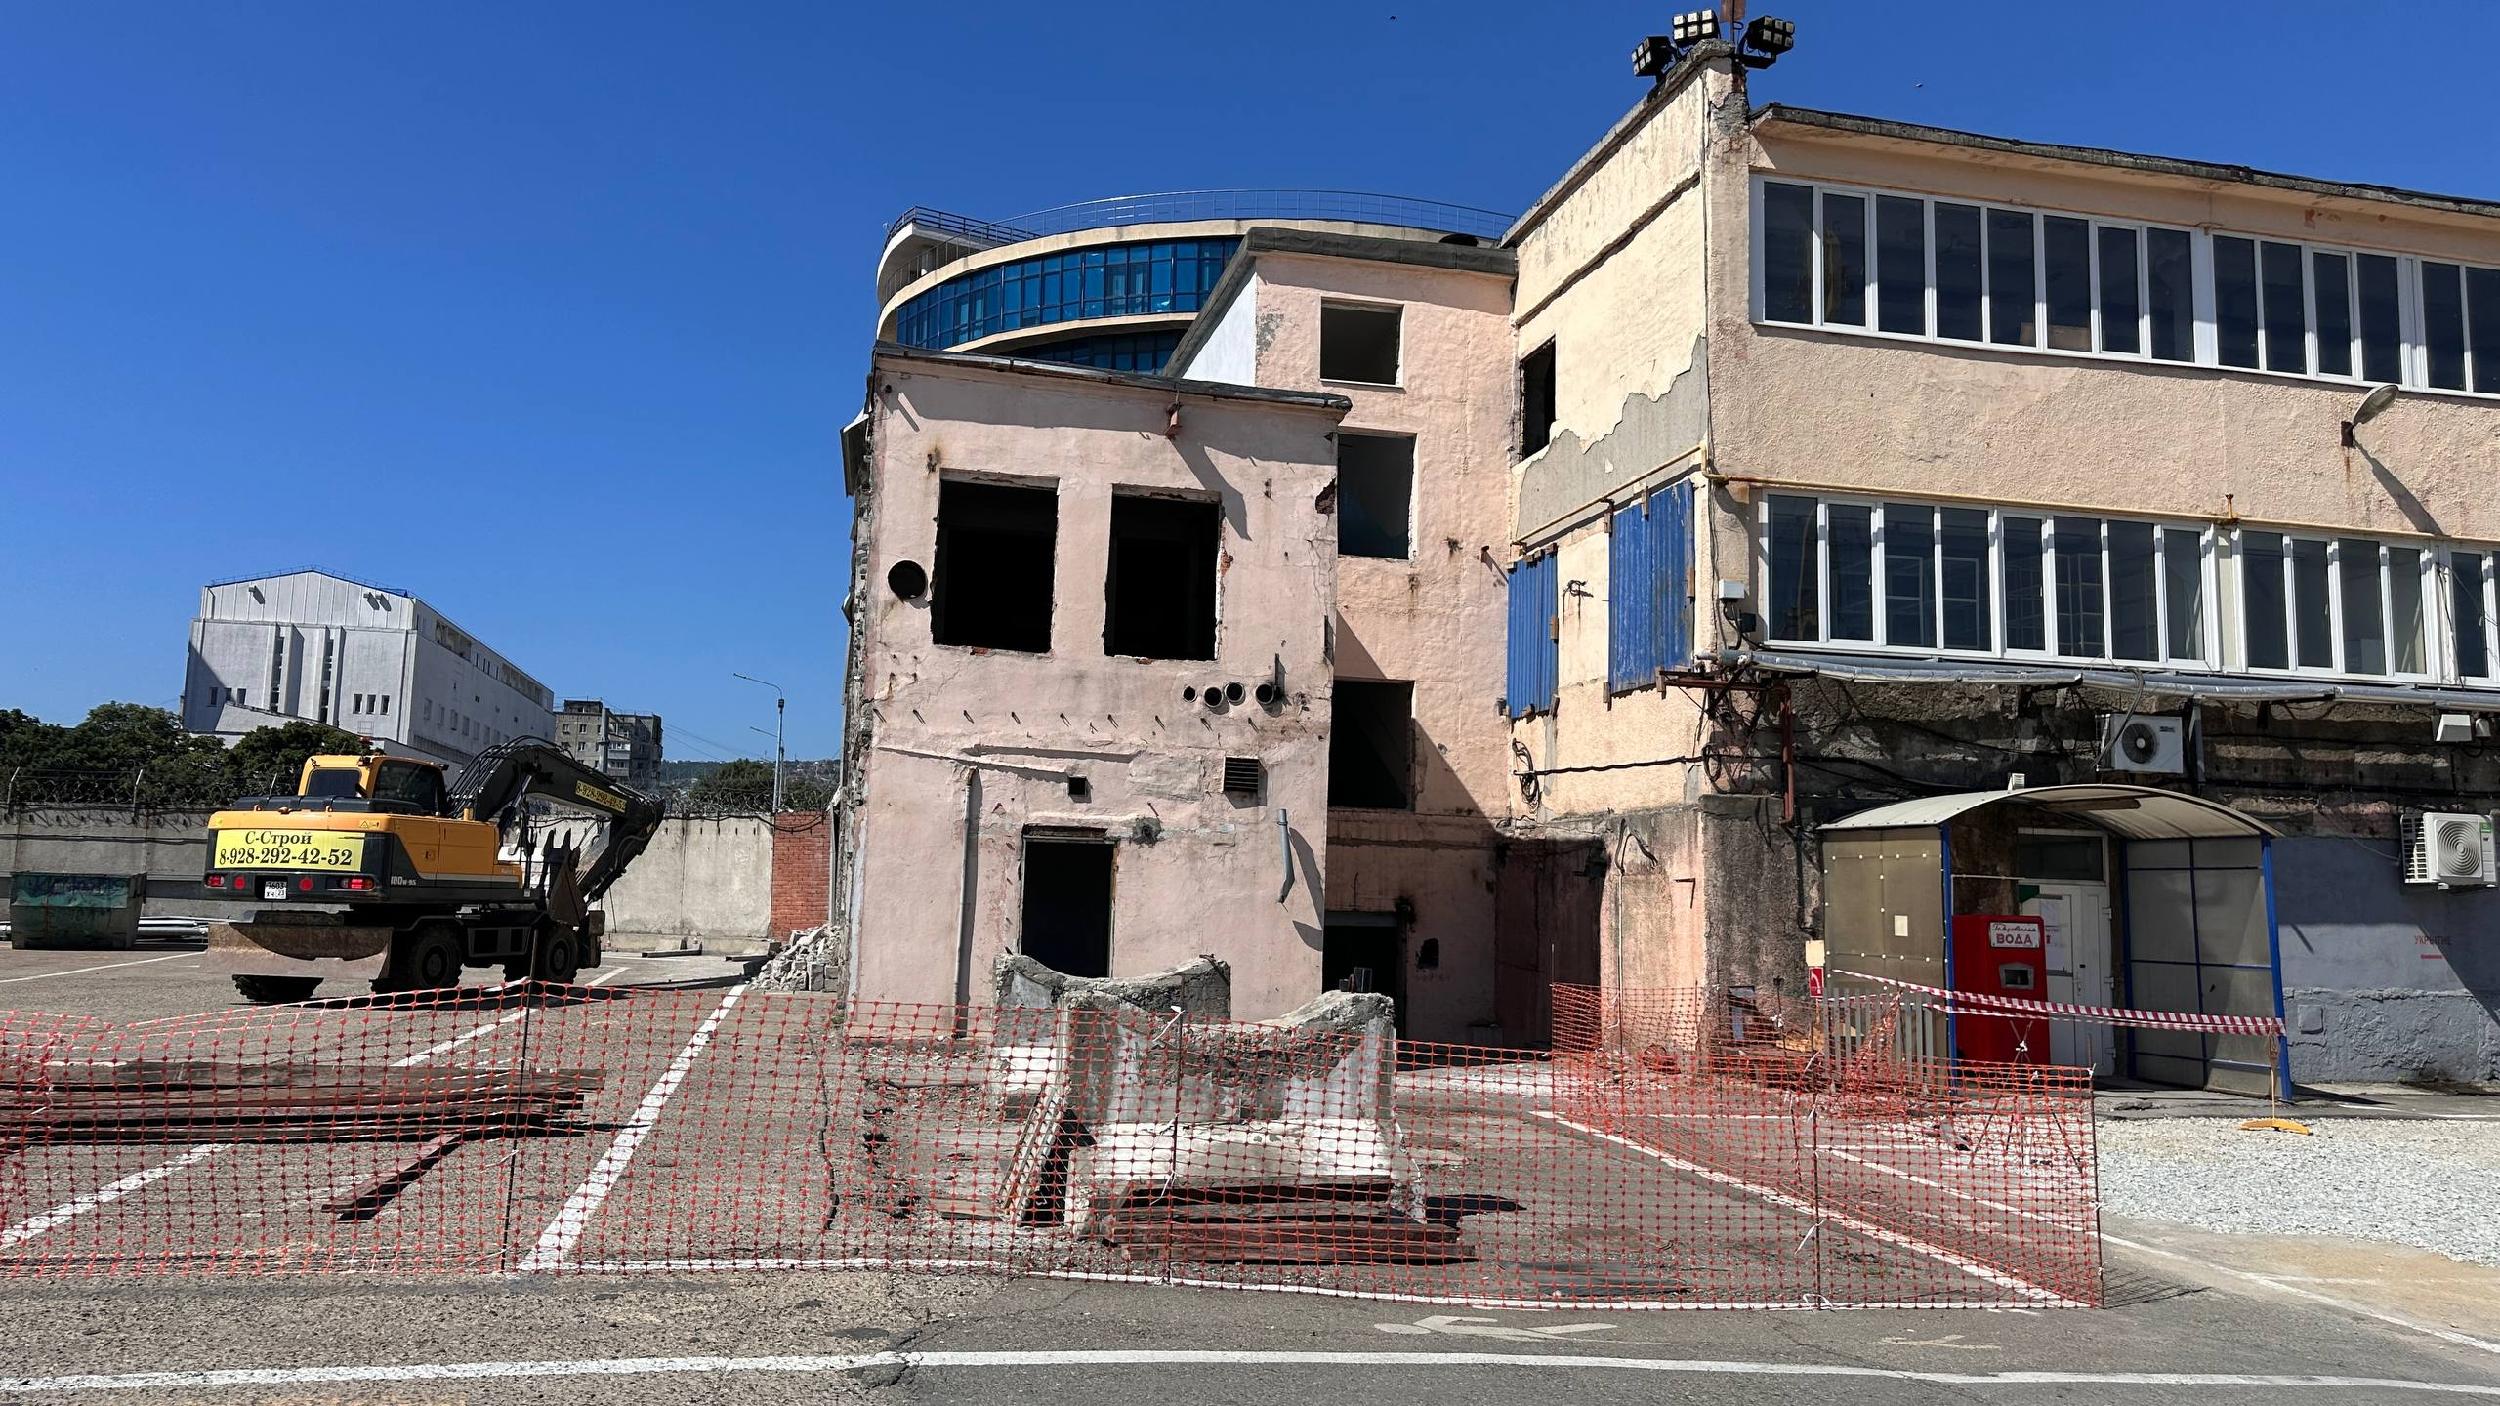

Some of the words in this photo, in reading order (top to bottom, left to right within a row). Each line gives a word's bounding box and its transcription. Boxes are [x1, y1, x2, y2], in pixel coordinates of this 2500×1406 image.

[245, 831, 312, 847] С-Строй
[219, 848, 353, 865] 8-928-292-42-52
[1996, 933, 2032, 944] ВОДА
